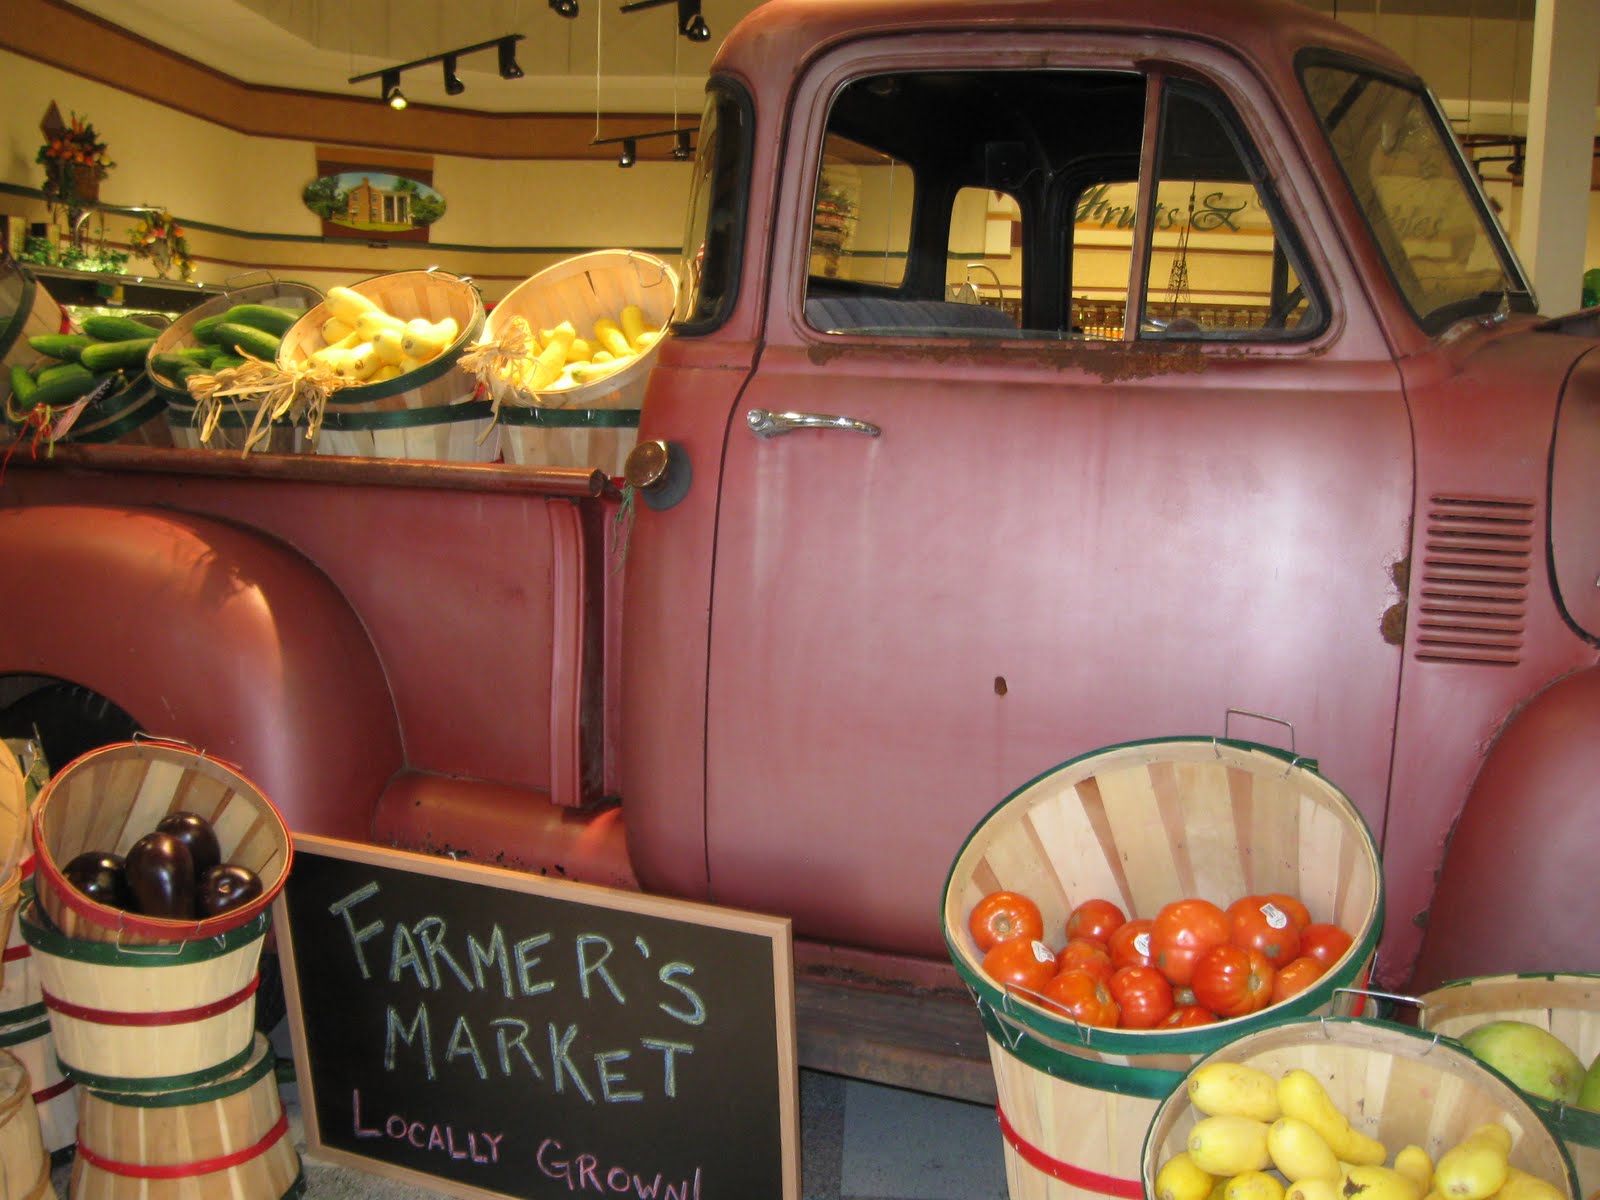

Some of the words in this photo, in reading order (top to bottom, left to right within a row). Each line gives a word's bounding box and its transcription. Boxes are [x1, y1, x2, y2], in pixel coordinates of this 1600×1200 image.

[1190, 192, 1247, 232] &
[328, 881, 706, 1025] FARMER'S
[384, 1002, 694, 1103] MARKET
[352, 1088, 503, 1163] LOCALLY
